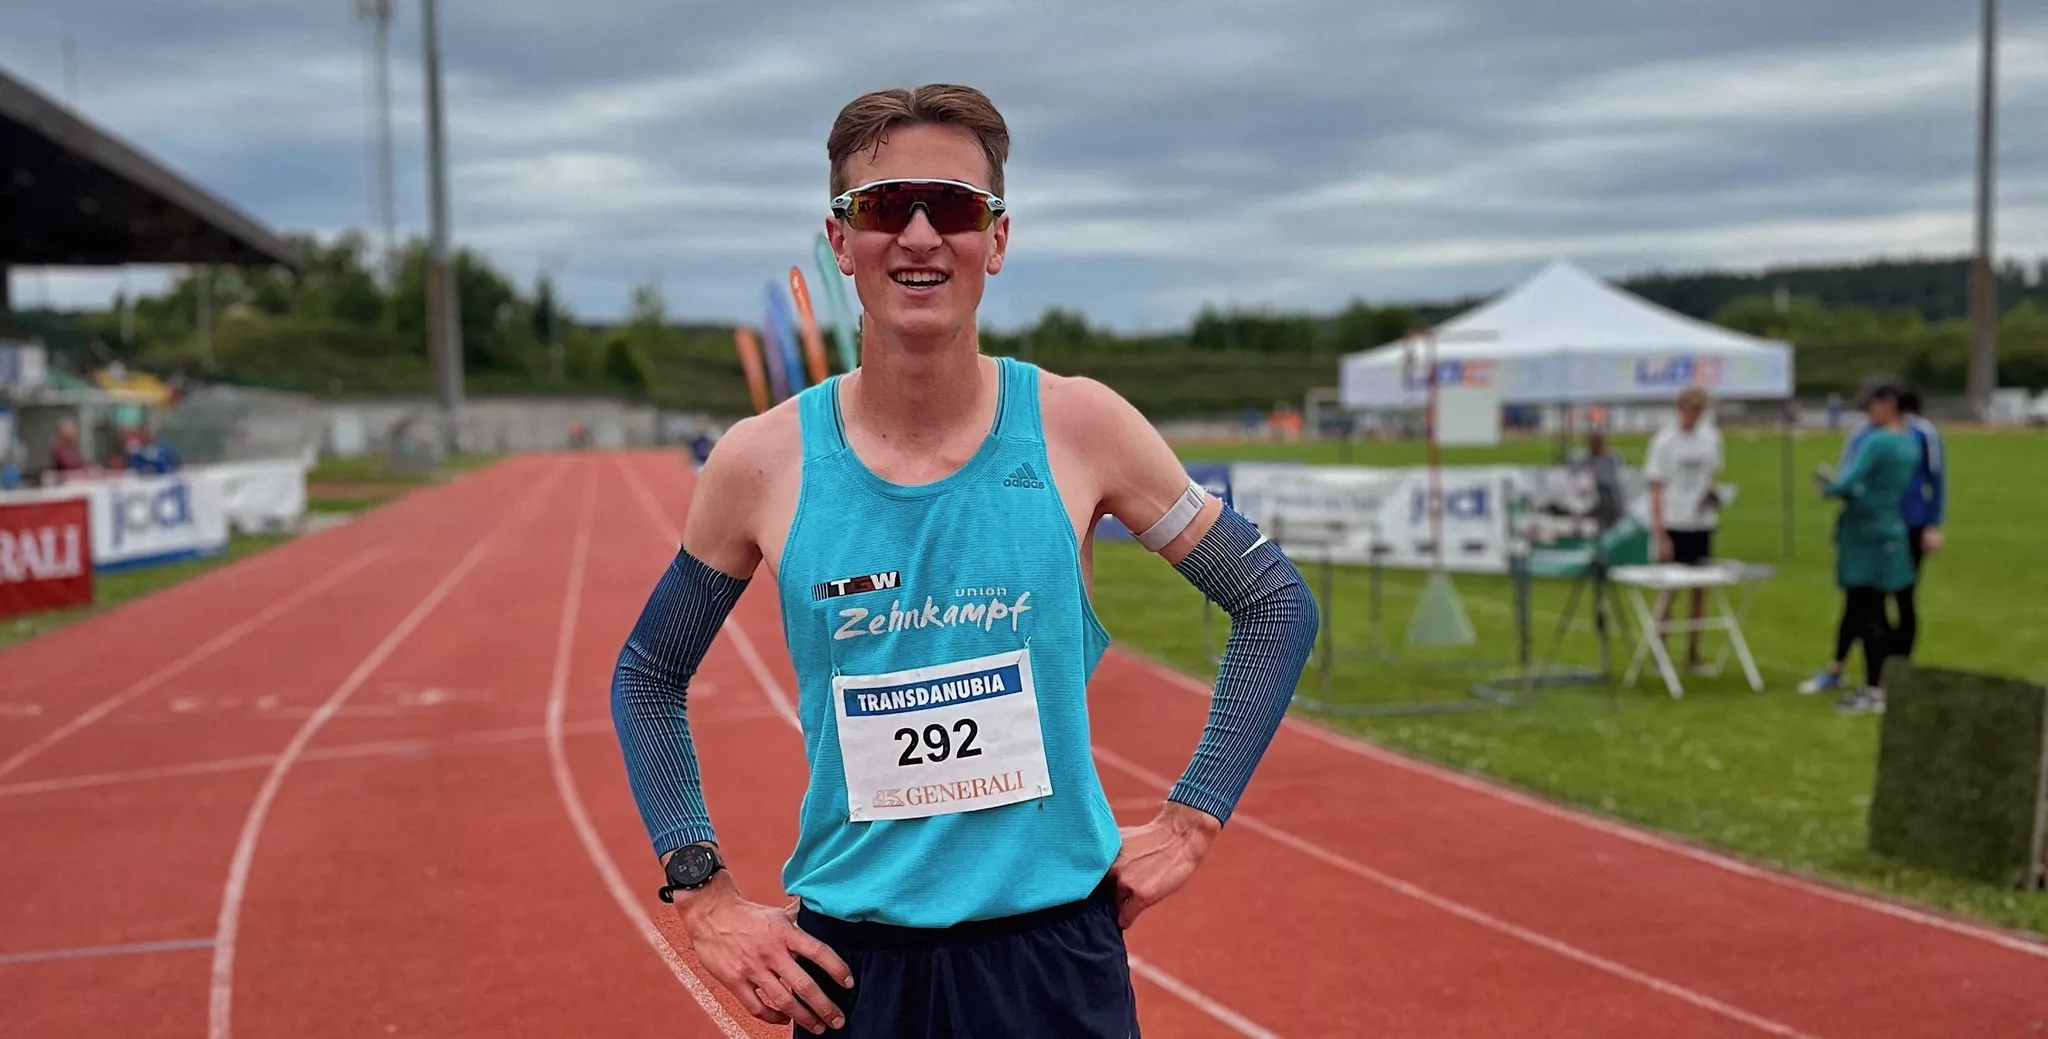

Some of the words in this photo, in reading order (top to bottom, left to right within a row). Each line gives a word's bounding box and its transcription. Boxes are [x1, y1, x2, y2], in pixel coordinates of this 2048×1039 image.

[1003, 478, 1045, 489] adidas
[830, 570, 897, 596] TGW
[834, 590, 1032, 640] Zehnkampf
[857, 673, 1006, 712] TRANSDANUBIA
[893, 718, 983, 767] 292
[905, 769, 1025, 806] GENERALI
